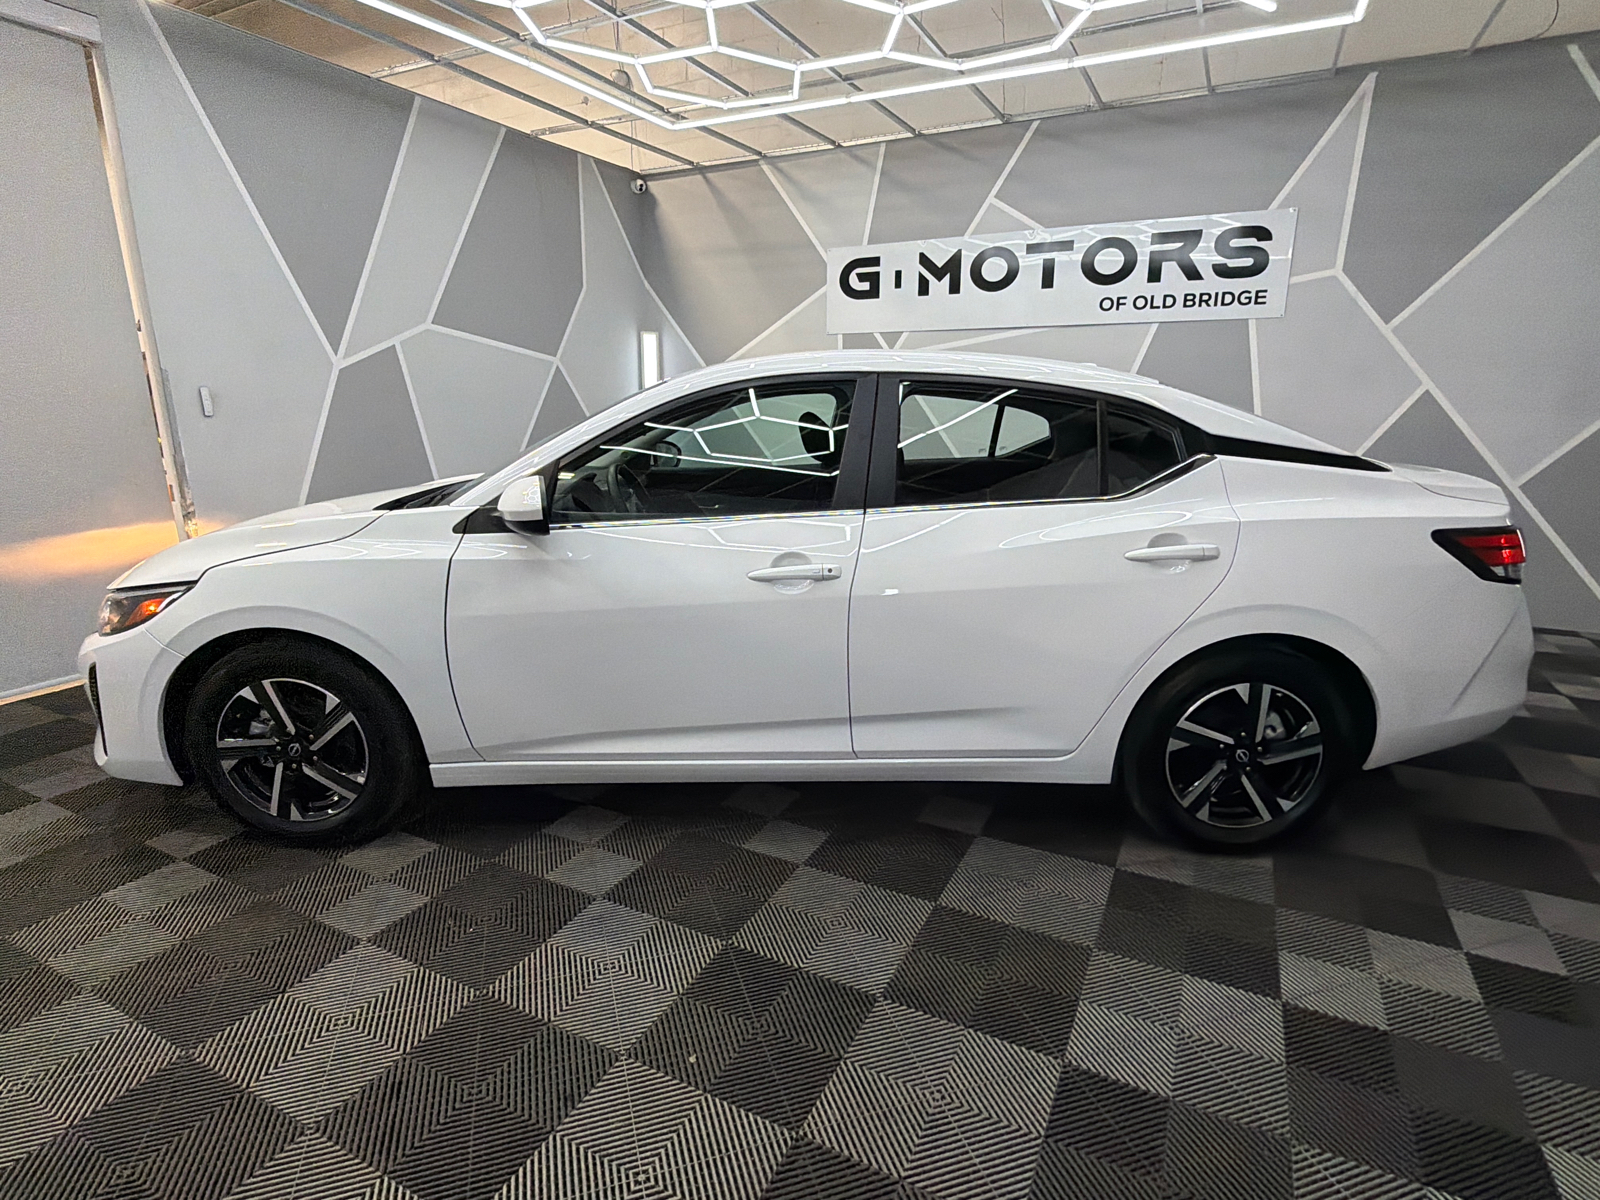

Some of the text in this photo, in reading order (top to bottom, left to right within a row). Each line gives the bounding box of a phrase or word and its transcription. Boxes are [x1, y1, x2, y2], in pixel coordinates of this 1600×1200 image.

[918, 225, 1273, 297] MOTORS
[1099, 289, 1268, 312] OF OLD BRIDGE
